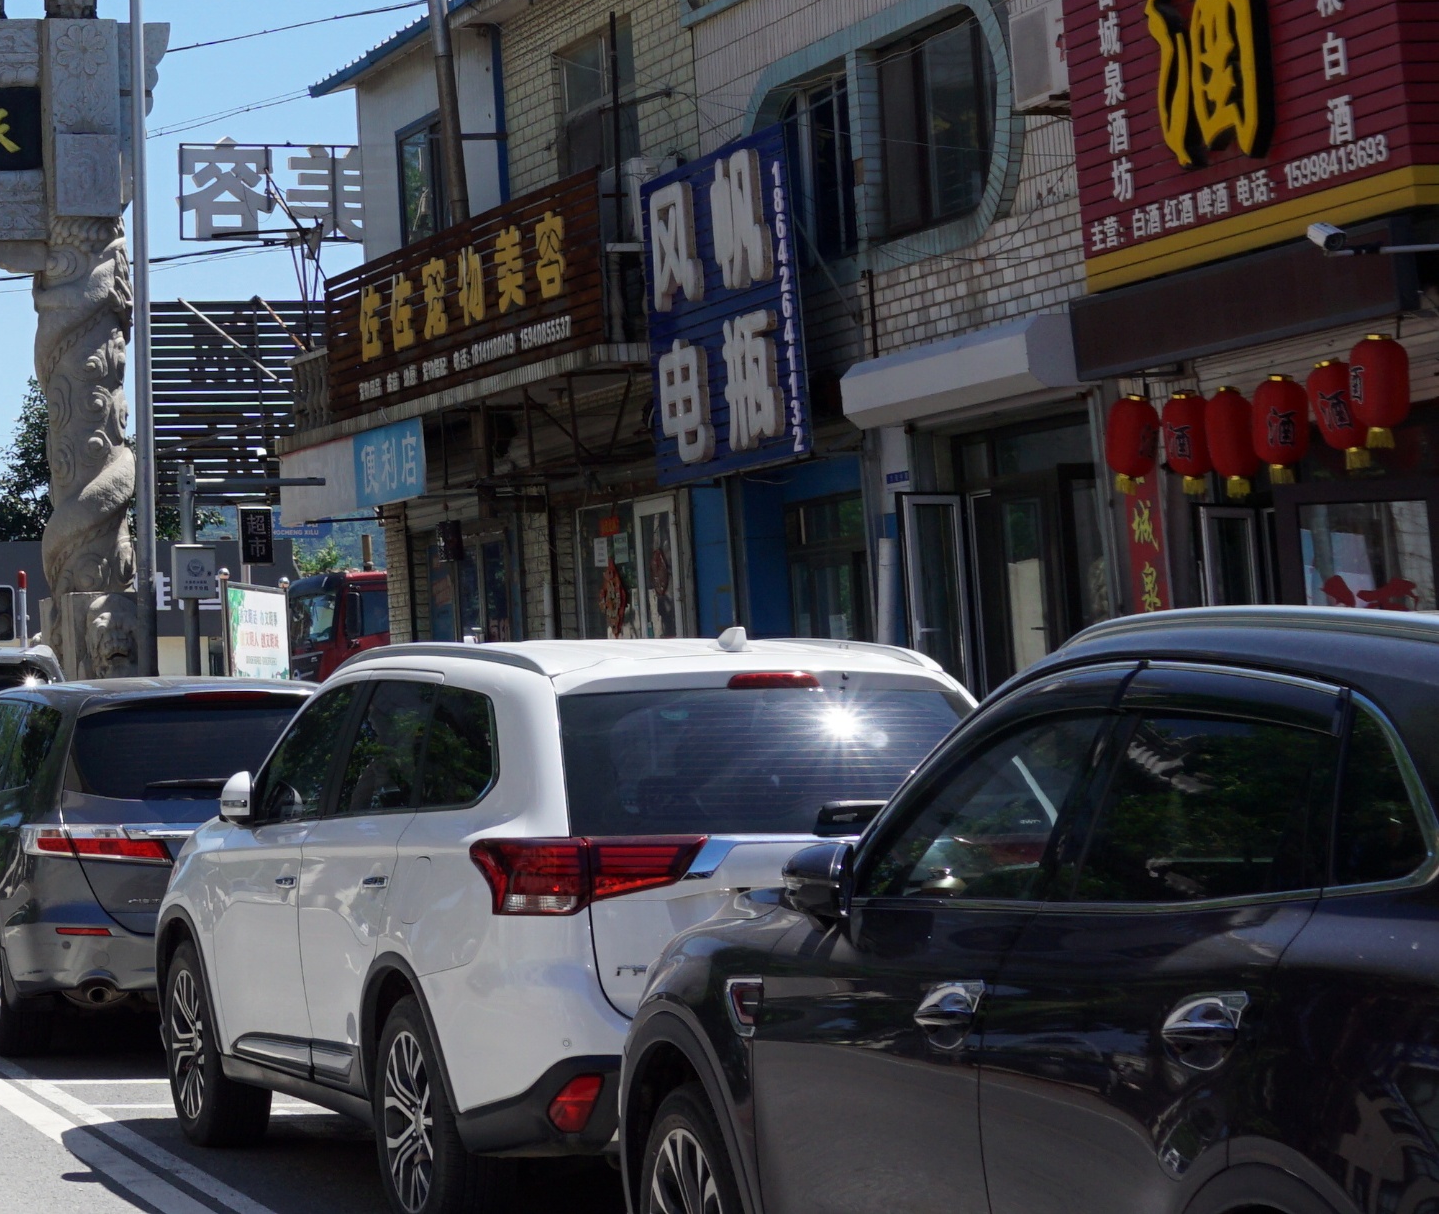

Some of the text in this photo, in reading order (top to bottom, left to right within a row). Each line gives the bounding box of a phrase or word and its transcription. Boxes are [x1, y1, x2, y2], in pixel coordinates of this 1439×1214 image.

[1132, 203, 1163, 240] 白酒
[1164, 194, 1197, 232] 红酒
[1198, 182, 1230, 217] 啤酒
[1284, 134, 1389, 189] 15998413693
[359, 211, 566, 362] 佐佐宠物美容
[771, 161, 804, 452] 18642641132
[520, 316, 572, 349] 15940855537
[1268, 407, 1298, 447] 酒
[1317, 389, 1354, 431] 酒
[361, 431, 417, 495] 便利店
[1167, 421, 1193, 461] 酒
[247, 514, 266, 558] 超市
